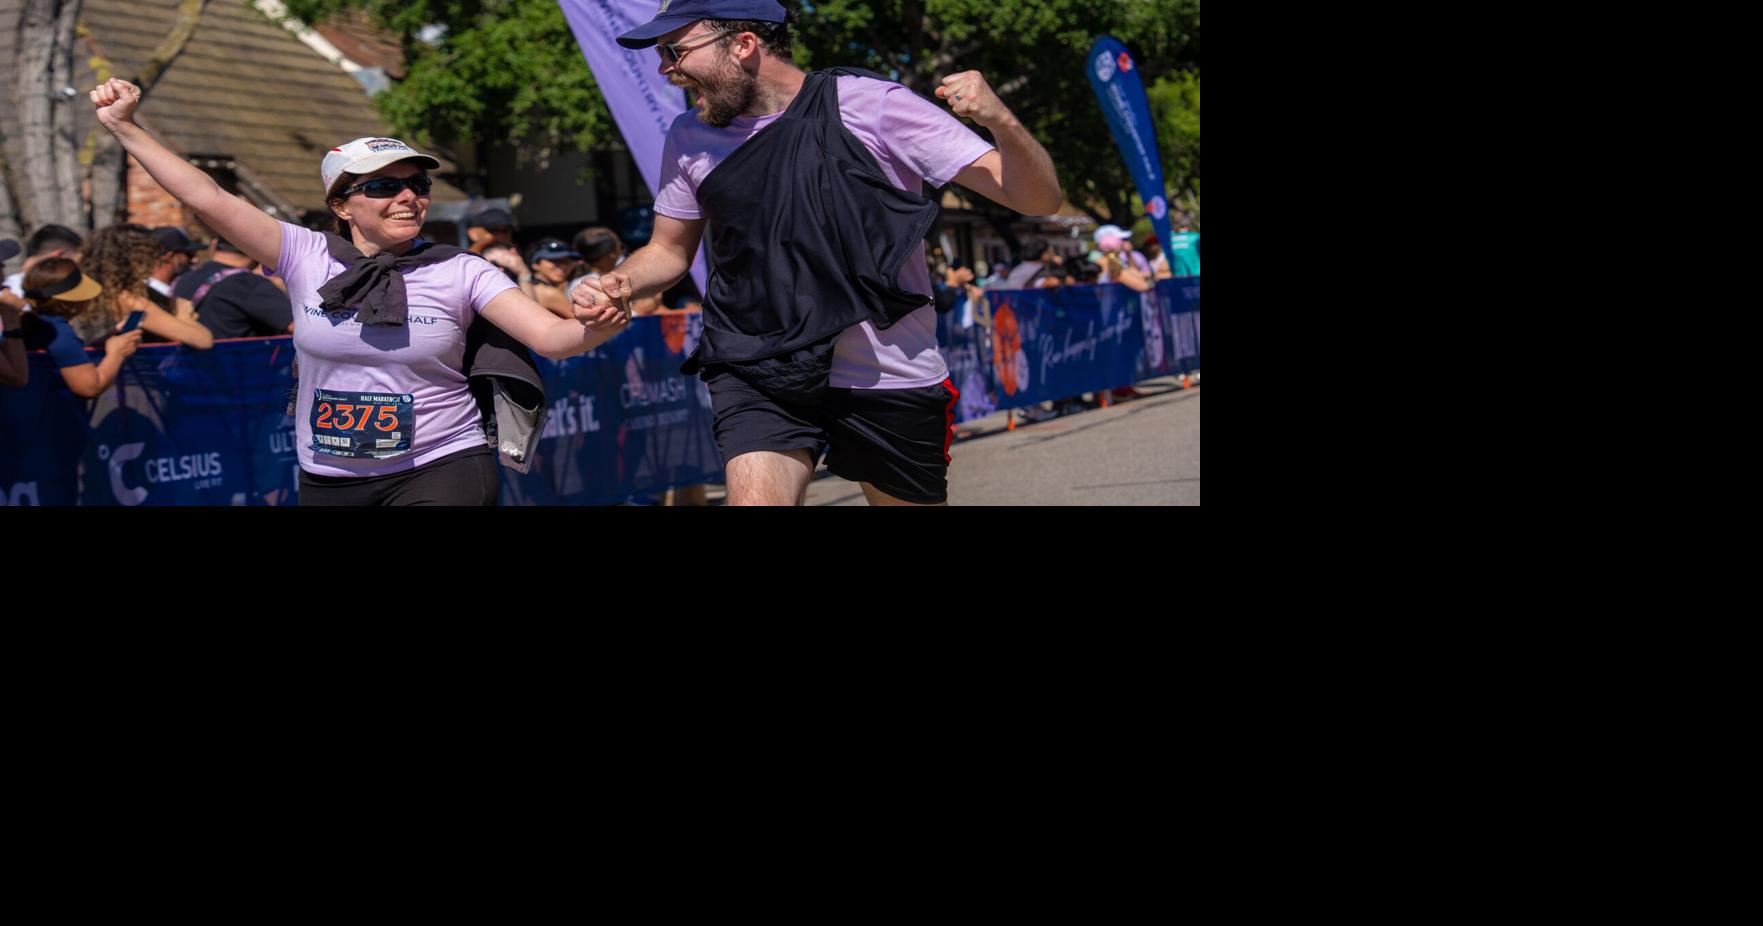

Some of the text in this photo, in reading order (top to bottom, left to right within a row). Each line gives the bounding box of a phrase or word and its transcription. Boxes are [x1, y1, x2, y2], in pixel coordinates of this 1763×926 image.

[316, 402, 399, 432] 2375
[269, 431, 297, 454] ULT
[145, 452, 222, 483] CELSIUS
